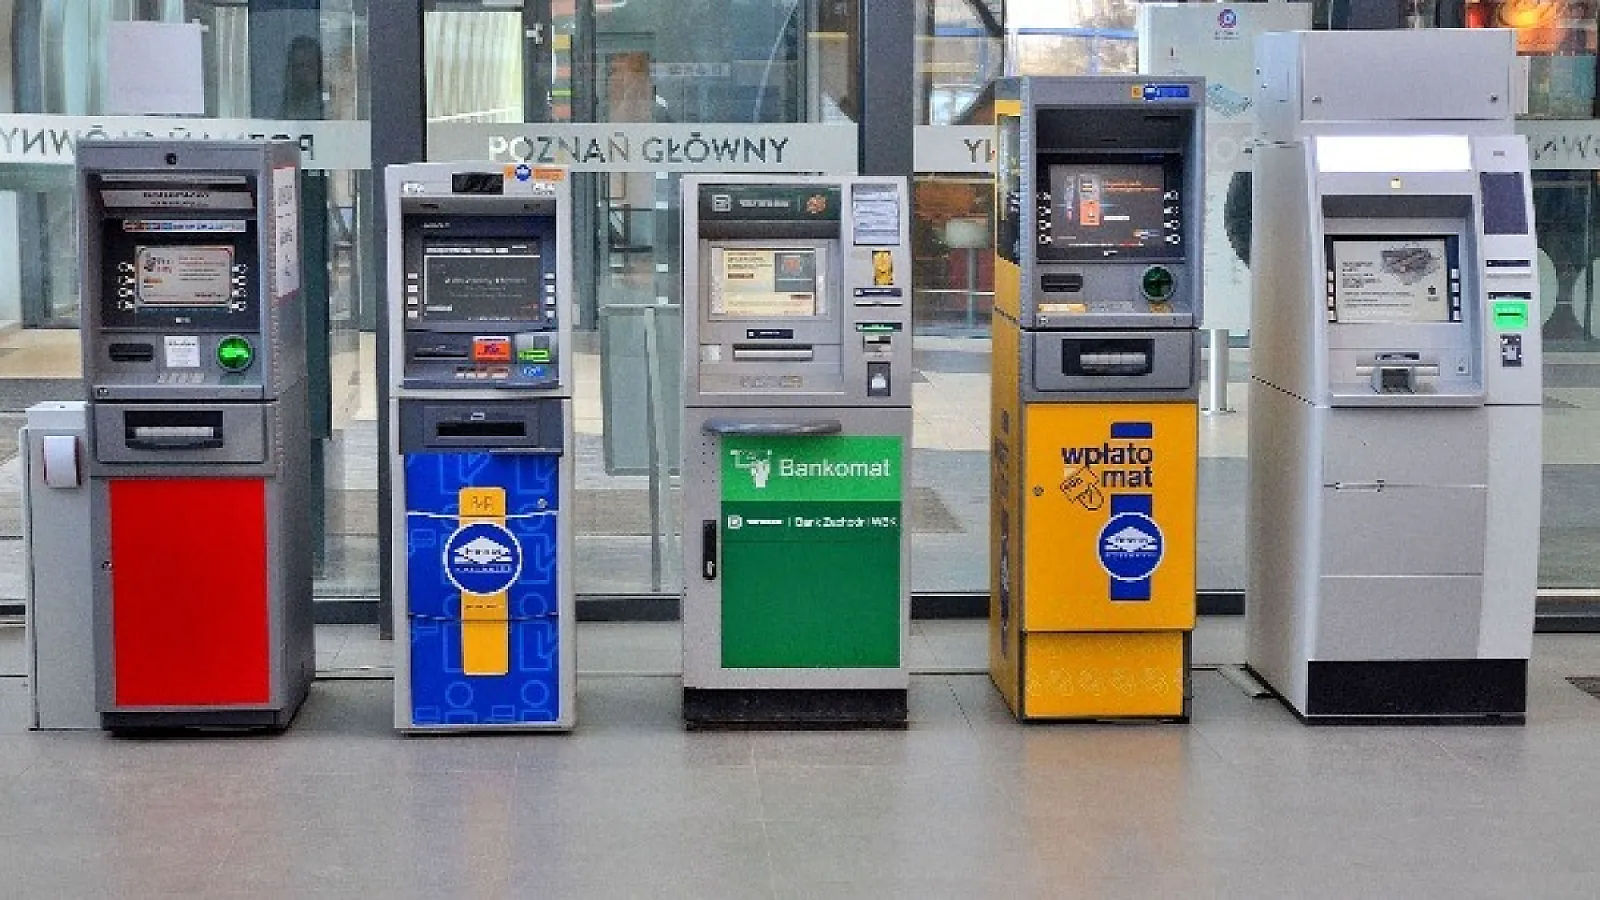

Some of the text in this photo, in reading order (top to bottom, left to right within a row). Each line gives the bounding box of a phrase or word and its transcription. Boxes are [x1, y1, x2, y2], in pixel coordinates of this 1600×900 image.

[488, 131, 789, 163] POZNAŃ GŁÓWNY
[779, 459, 892, 477] Bankomat
[1102, 466, 1153, 488] mat
